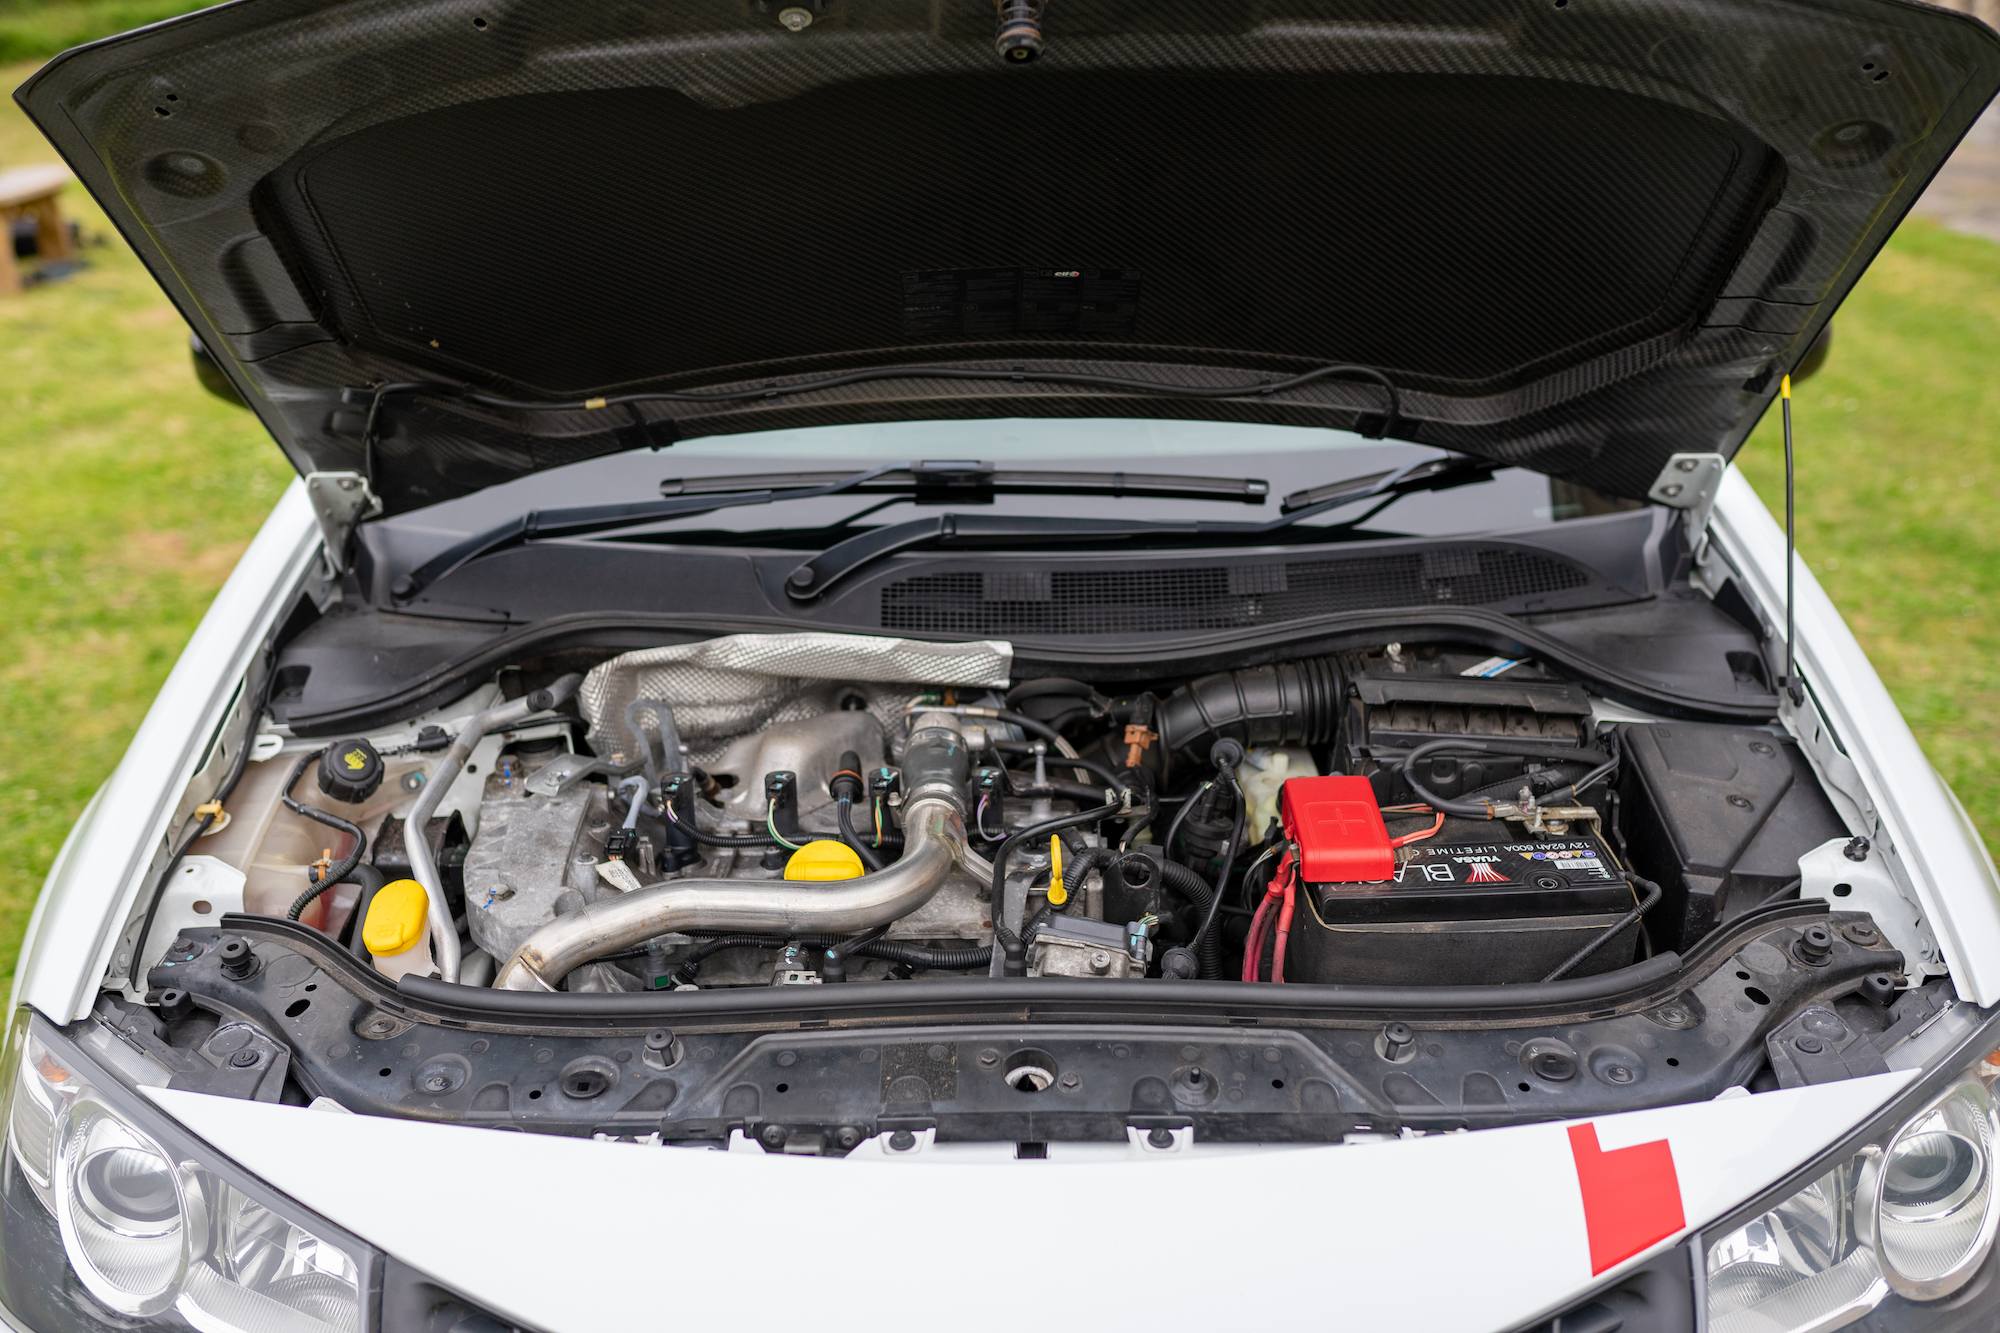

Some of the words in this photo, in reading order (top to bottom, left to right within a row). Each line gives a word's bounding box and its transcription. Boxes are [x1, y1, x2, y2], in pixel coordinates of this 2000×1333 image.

[1426, 845, 1498, 856] LIFETIME
[1503, 844, 1534, 852] 600A
[1536, 842, 1567, 851] 62Ah
[1569, 842, 1591, 850] 12V
[1453, 855, 1502, 864] YUASA
